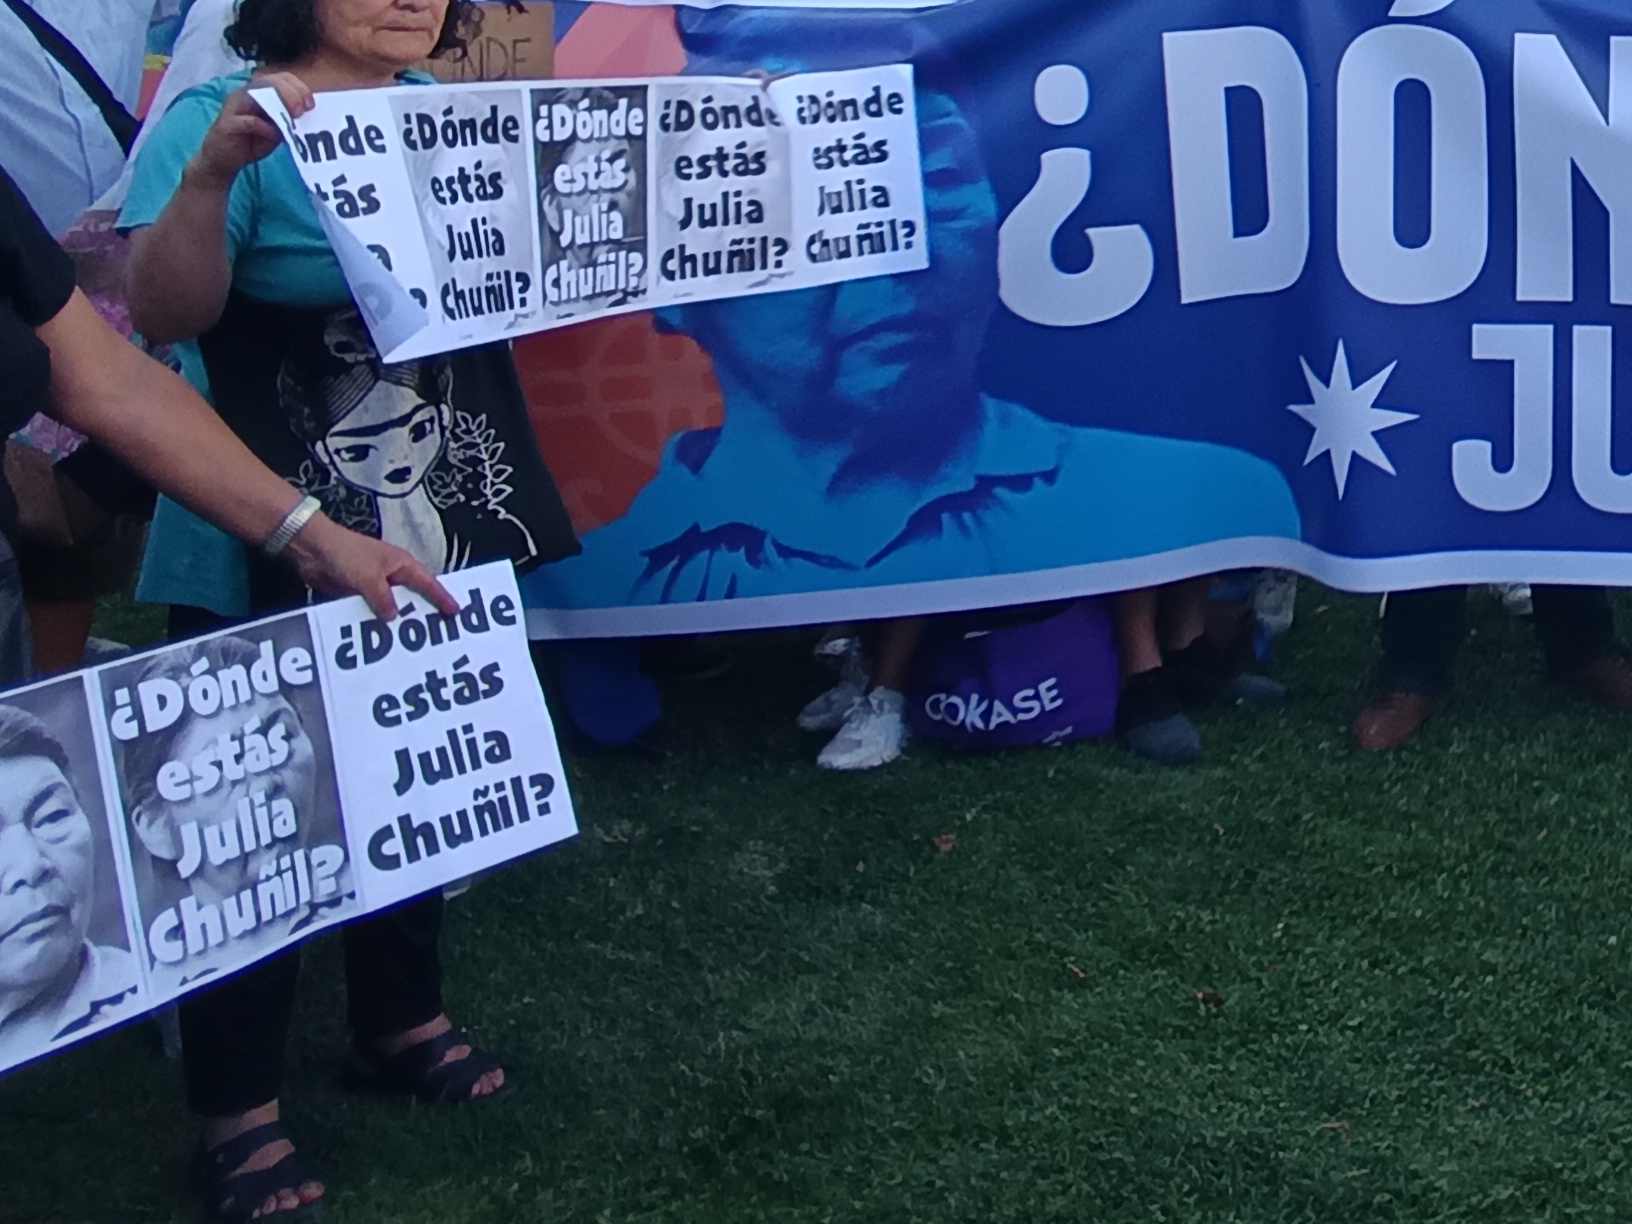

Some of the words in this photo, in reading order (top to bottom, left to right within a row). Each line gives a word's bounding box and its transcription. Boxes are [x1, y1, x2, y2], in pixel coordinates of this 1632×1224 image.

[402, 104, 520, 152] ¿Dónde
[535, 97, 644, 144] ¿Dónde
[430, 160, 504, 206] estás
[553, 148, 629, 196] estás
[674, 140, 768, 181] estás
[678, 190, 764, 232] Julia
[817, 178, 890, 217] Julia
[446, 216, 506, 263] Julia
[558, 200, 625, 249] Julia
[334, 587, 517, 671] ¿Dónde
[110, 638, 314, 741] ¿Dónde
[371, 654, 505, 728] estás
[156, 717, 293, 802] estás
[392, 724, 511, 797] Julia
[175, 789, 297, 879] Julia
